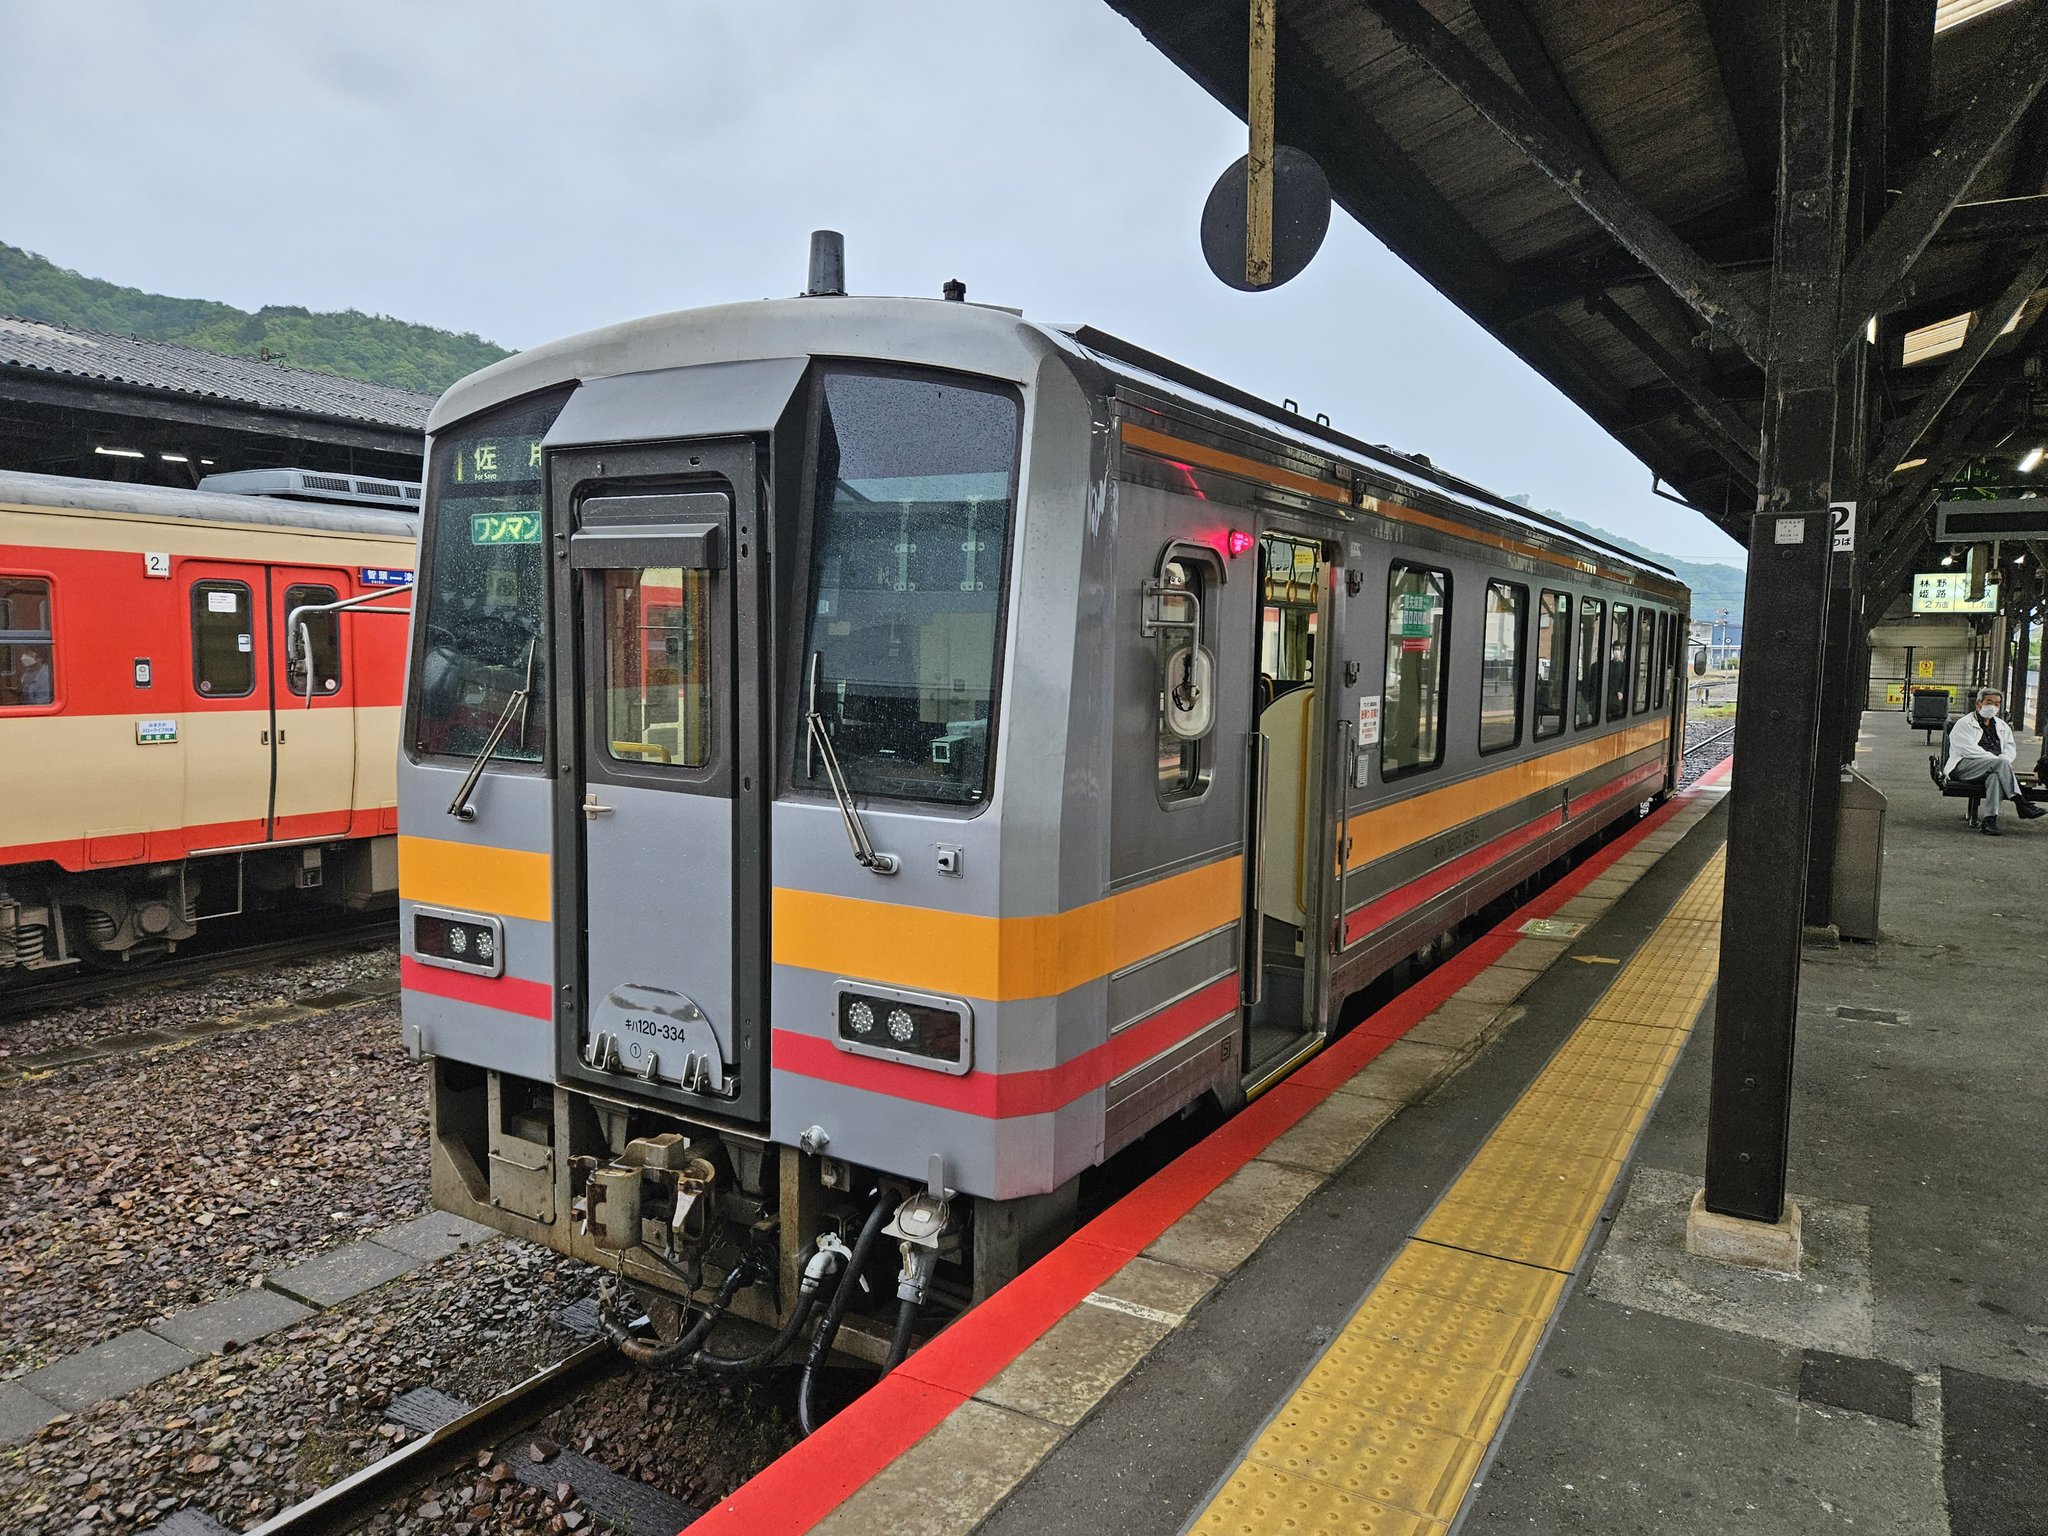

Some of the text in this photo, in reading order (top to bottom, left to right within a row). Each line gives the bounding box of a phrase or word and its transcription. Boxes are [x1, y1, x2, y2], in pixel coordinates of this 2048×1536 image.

[474, 516, 540, 541] ワンマン
[1830, 506, 1850, 535] 2
[625, 1018, 686, 1043] キハ120-334
